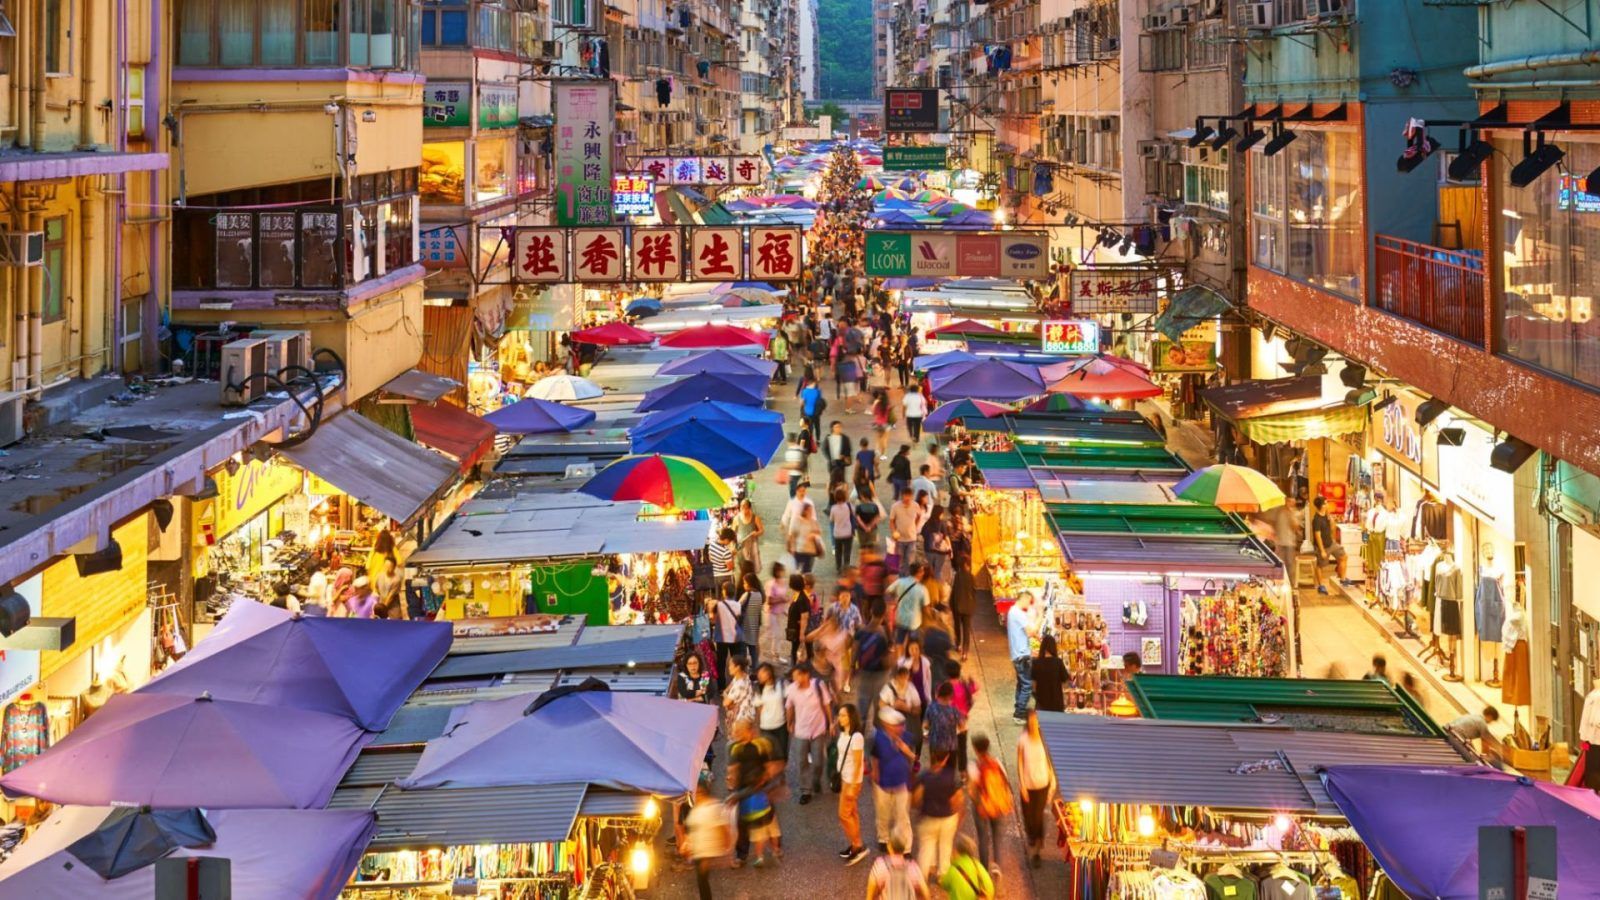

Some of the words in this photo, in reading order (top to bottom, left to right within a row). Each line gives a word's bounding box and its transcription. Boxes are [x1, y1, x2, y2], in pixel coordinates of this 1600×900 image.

[584, 121, 601, 181] 永興隆
[917, 260, 950, 270] Wacoal
